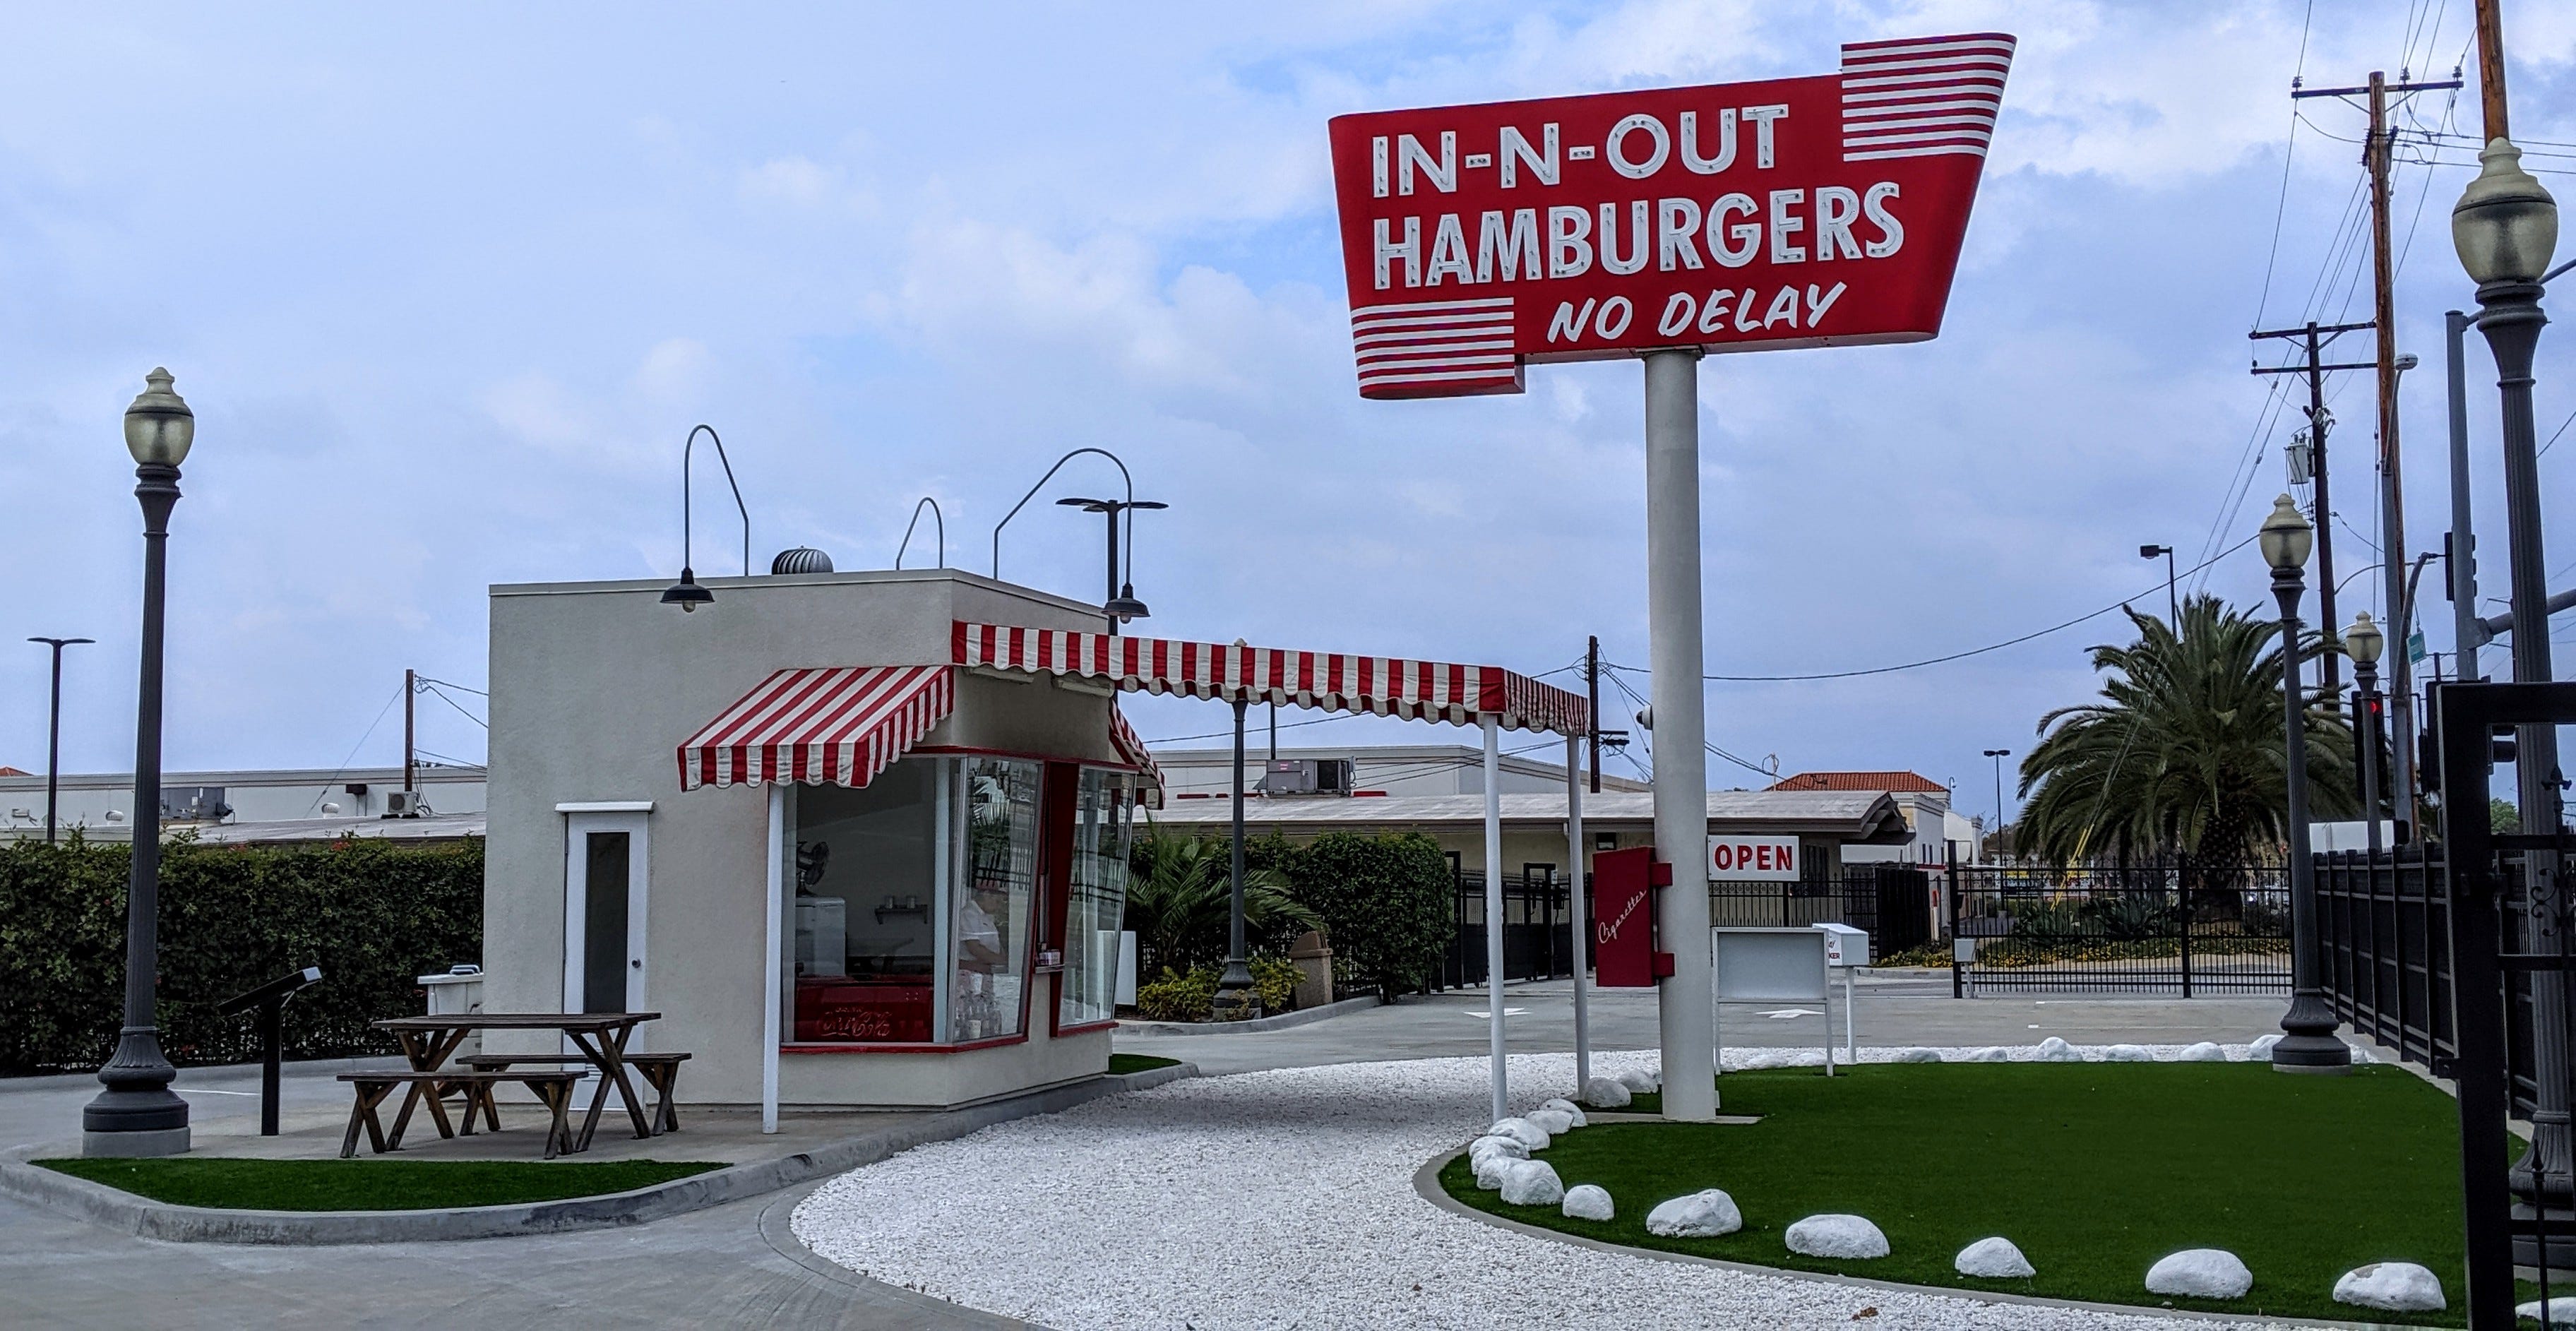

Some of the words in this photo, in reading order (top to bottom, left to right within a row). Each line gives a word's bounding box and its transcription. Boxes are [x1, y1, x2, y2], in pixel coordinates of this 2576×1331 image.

[1372, 104, 1789, 198] IN-N-OUT
[1373, 181, 1904, 290] HAMBURGERS
[1547, 296, 1633, 343] NO
[1657, 281, 1847, 337] DELAY
[1715, 844, 1792, 871] OPEN
[1598, 890, 1647, 943] Cigarettes
